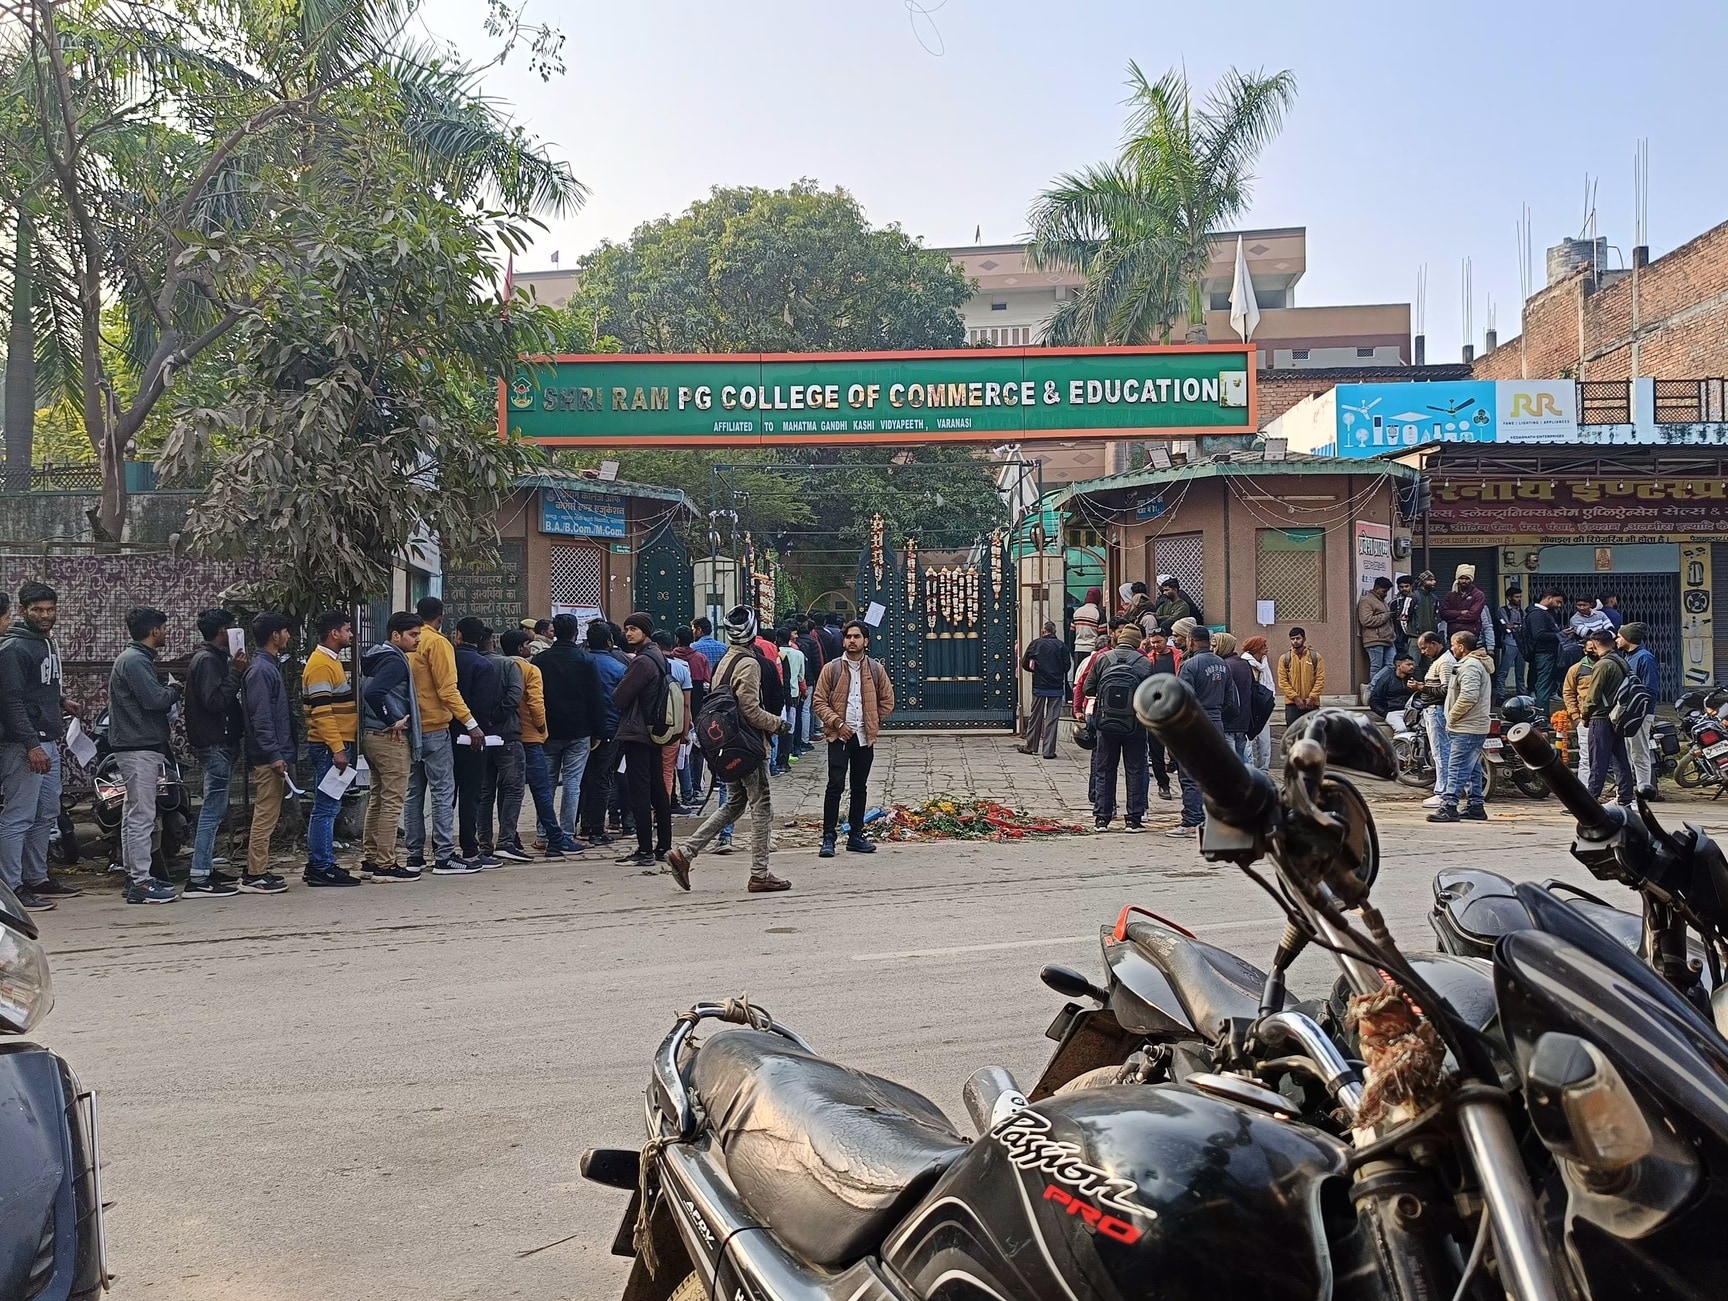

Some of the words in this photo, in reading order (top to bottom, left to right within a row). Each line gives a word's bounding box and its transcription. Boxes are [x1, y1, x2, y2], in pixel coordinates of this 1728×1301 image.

[543, 386, 603, 411] SHRI
[612, 386, 669, 411] RAM
[678, 385, 712, 410] PG
[721, 384, 839, 410] COLLEGE
[848, 383, 880, 409] OF
[889, 381, 1036, 408] COMMERCE
[1043, 379, 1061, 405] &
[1069, 377, 1218, 404] EDUCATION
[1510, 392, 1563, 418] RR
[713, 421, 753, 432] AFFILIATED
[763, 421, 774, 432] TO
[782, 420, 817, 432] MAHATMA
[820, 419, 848, 431] GANDHI
[852, 419, 875, 431] KASHI
[936, 417, 972, 429] VARANASI
[990, 1108, 1159, 1220] Passion
[1042, 1183, 1143, 1245] PRO
